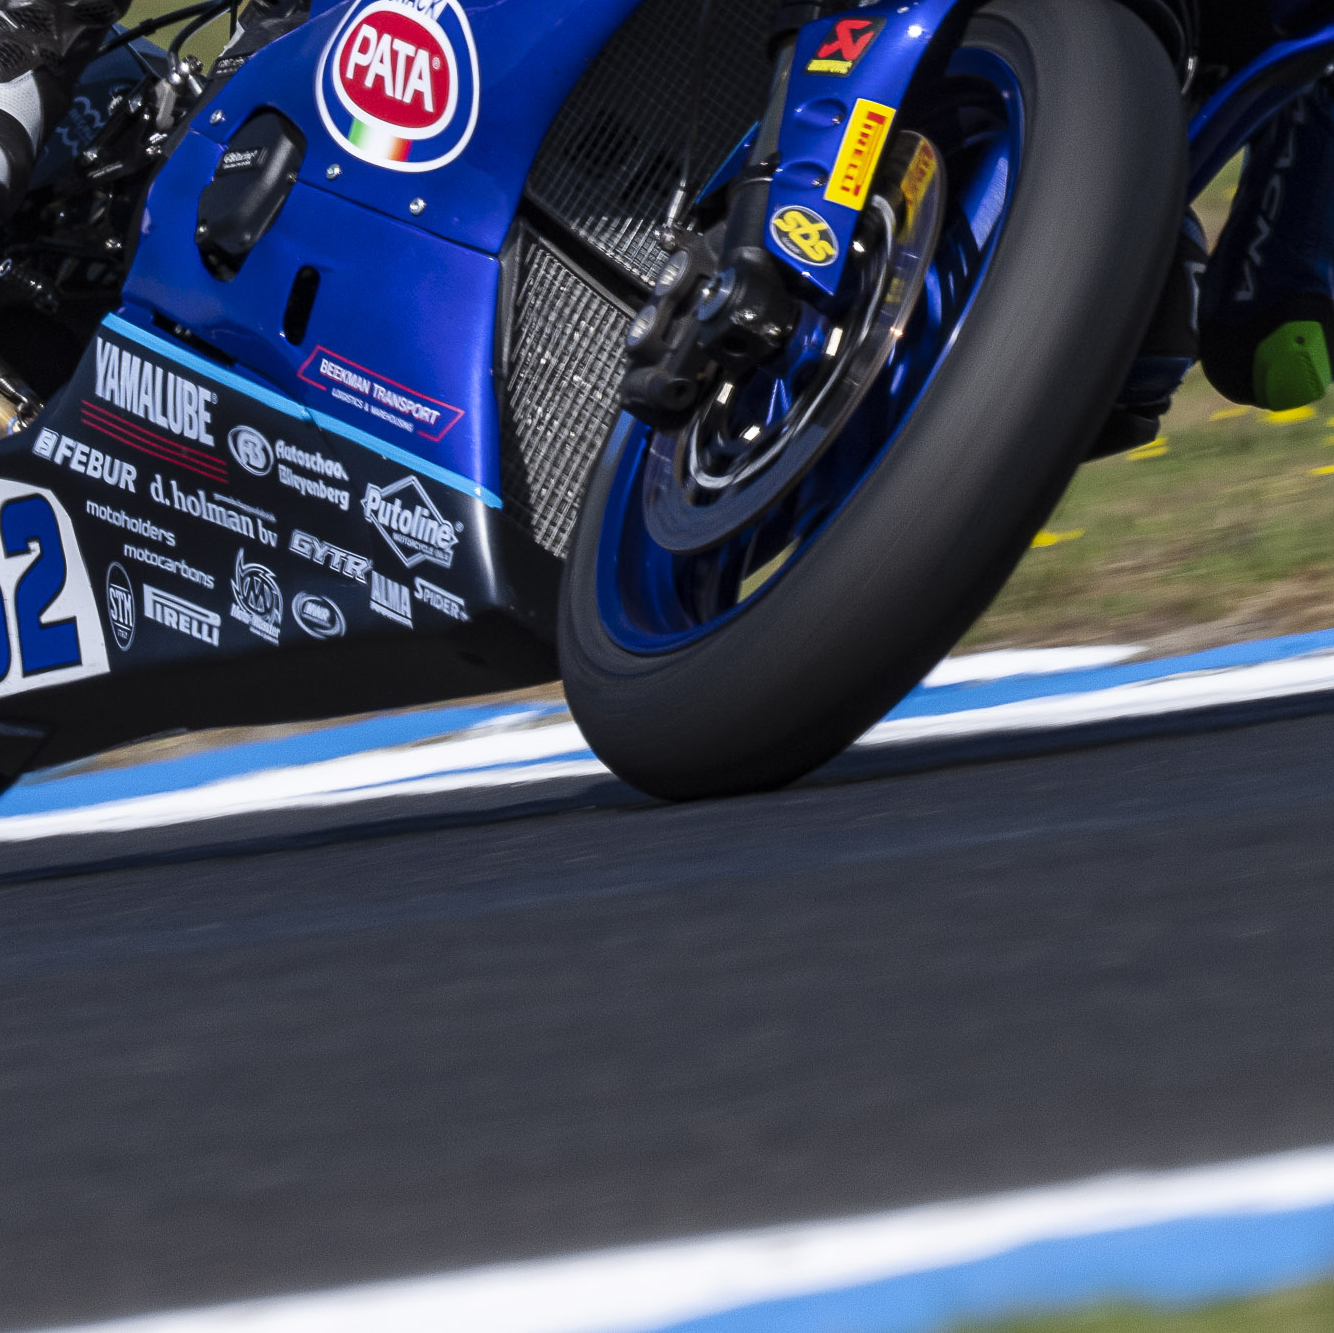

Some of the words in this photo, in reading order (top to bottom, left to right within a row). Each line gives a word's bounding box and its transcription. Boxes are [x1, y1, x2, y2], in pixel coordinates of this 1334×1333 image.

[346, 23, 434, 113] PATA
[840, 111, 887, 197] PIRELLI
[95, 337, 215, 447] YAMALUBE
[320, 358, 371, 395] BEEKMAN
[372, 383, 441, 425] TRANSPORT
[52, 434, 137, 493] FEBUR
[87, 500, 176, 547] motoholders
[365, 484, 454, 550] Putoline
[123, 543, 215, 590] motocartons
[289, 529, 369, 585] GYTR
[109, 587, 133, 627] STM
[143, 583, 221, 647] PIRELLI
[414, 576, 465, 619] SPIDER
